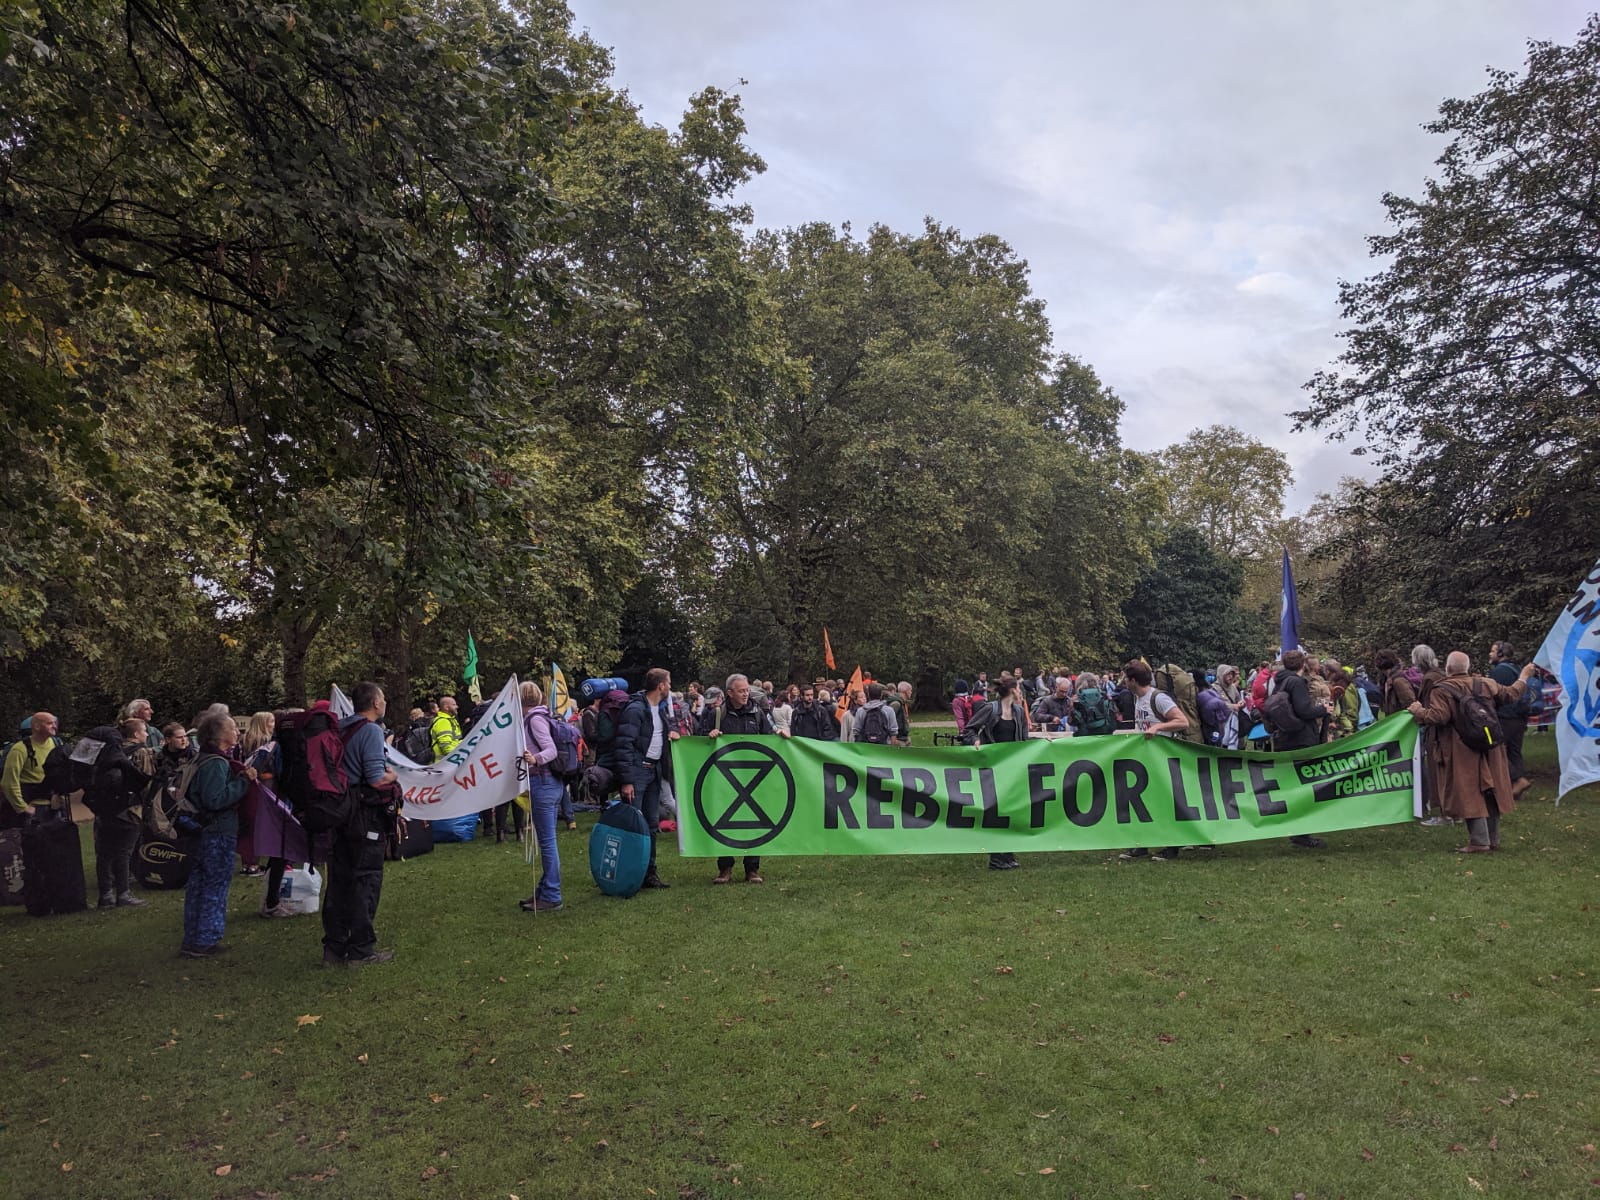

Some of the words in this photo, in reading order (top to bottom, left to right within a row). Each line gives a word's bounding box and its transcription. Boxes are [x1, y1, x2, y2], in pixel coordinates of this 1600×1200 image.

[403, 783, 446, 805] ARE
[453, 752, 503, 791] WE
[1300, 748, 1389, 779] extinction
[1335, 763, 1413, 796] rebellion
[823, 762, 1010, 830] REBEL
[1028, 759, 1153, 828] FOR
[1167, 757, 1288, 822] LIFE
[149, 847, 187, 862] SWIFT
